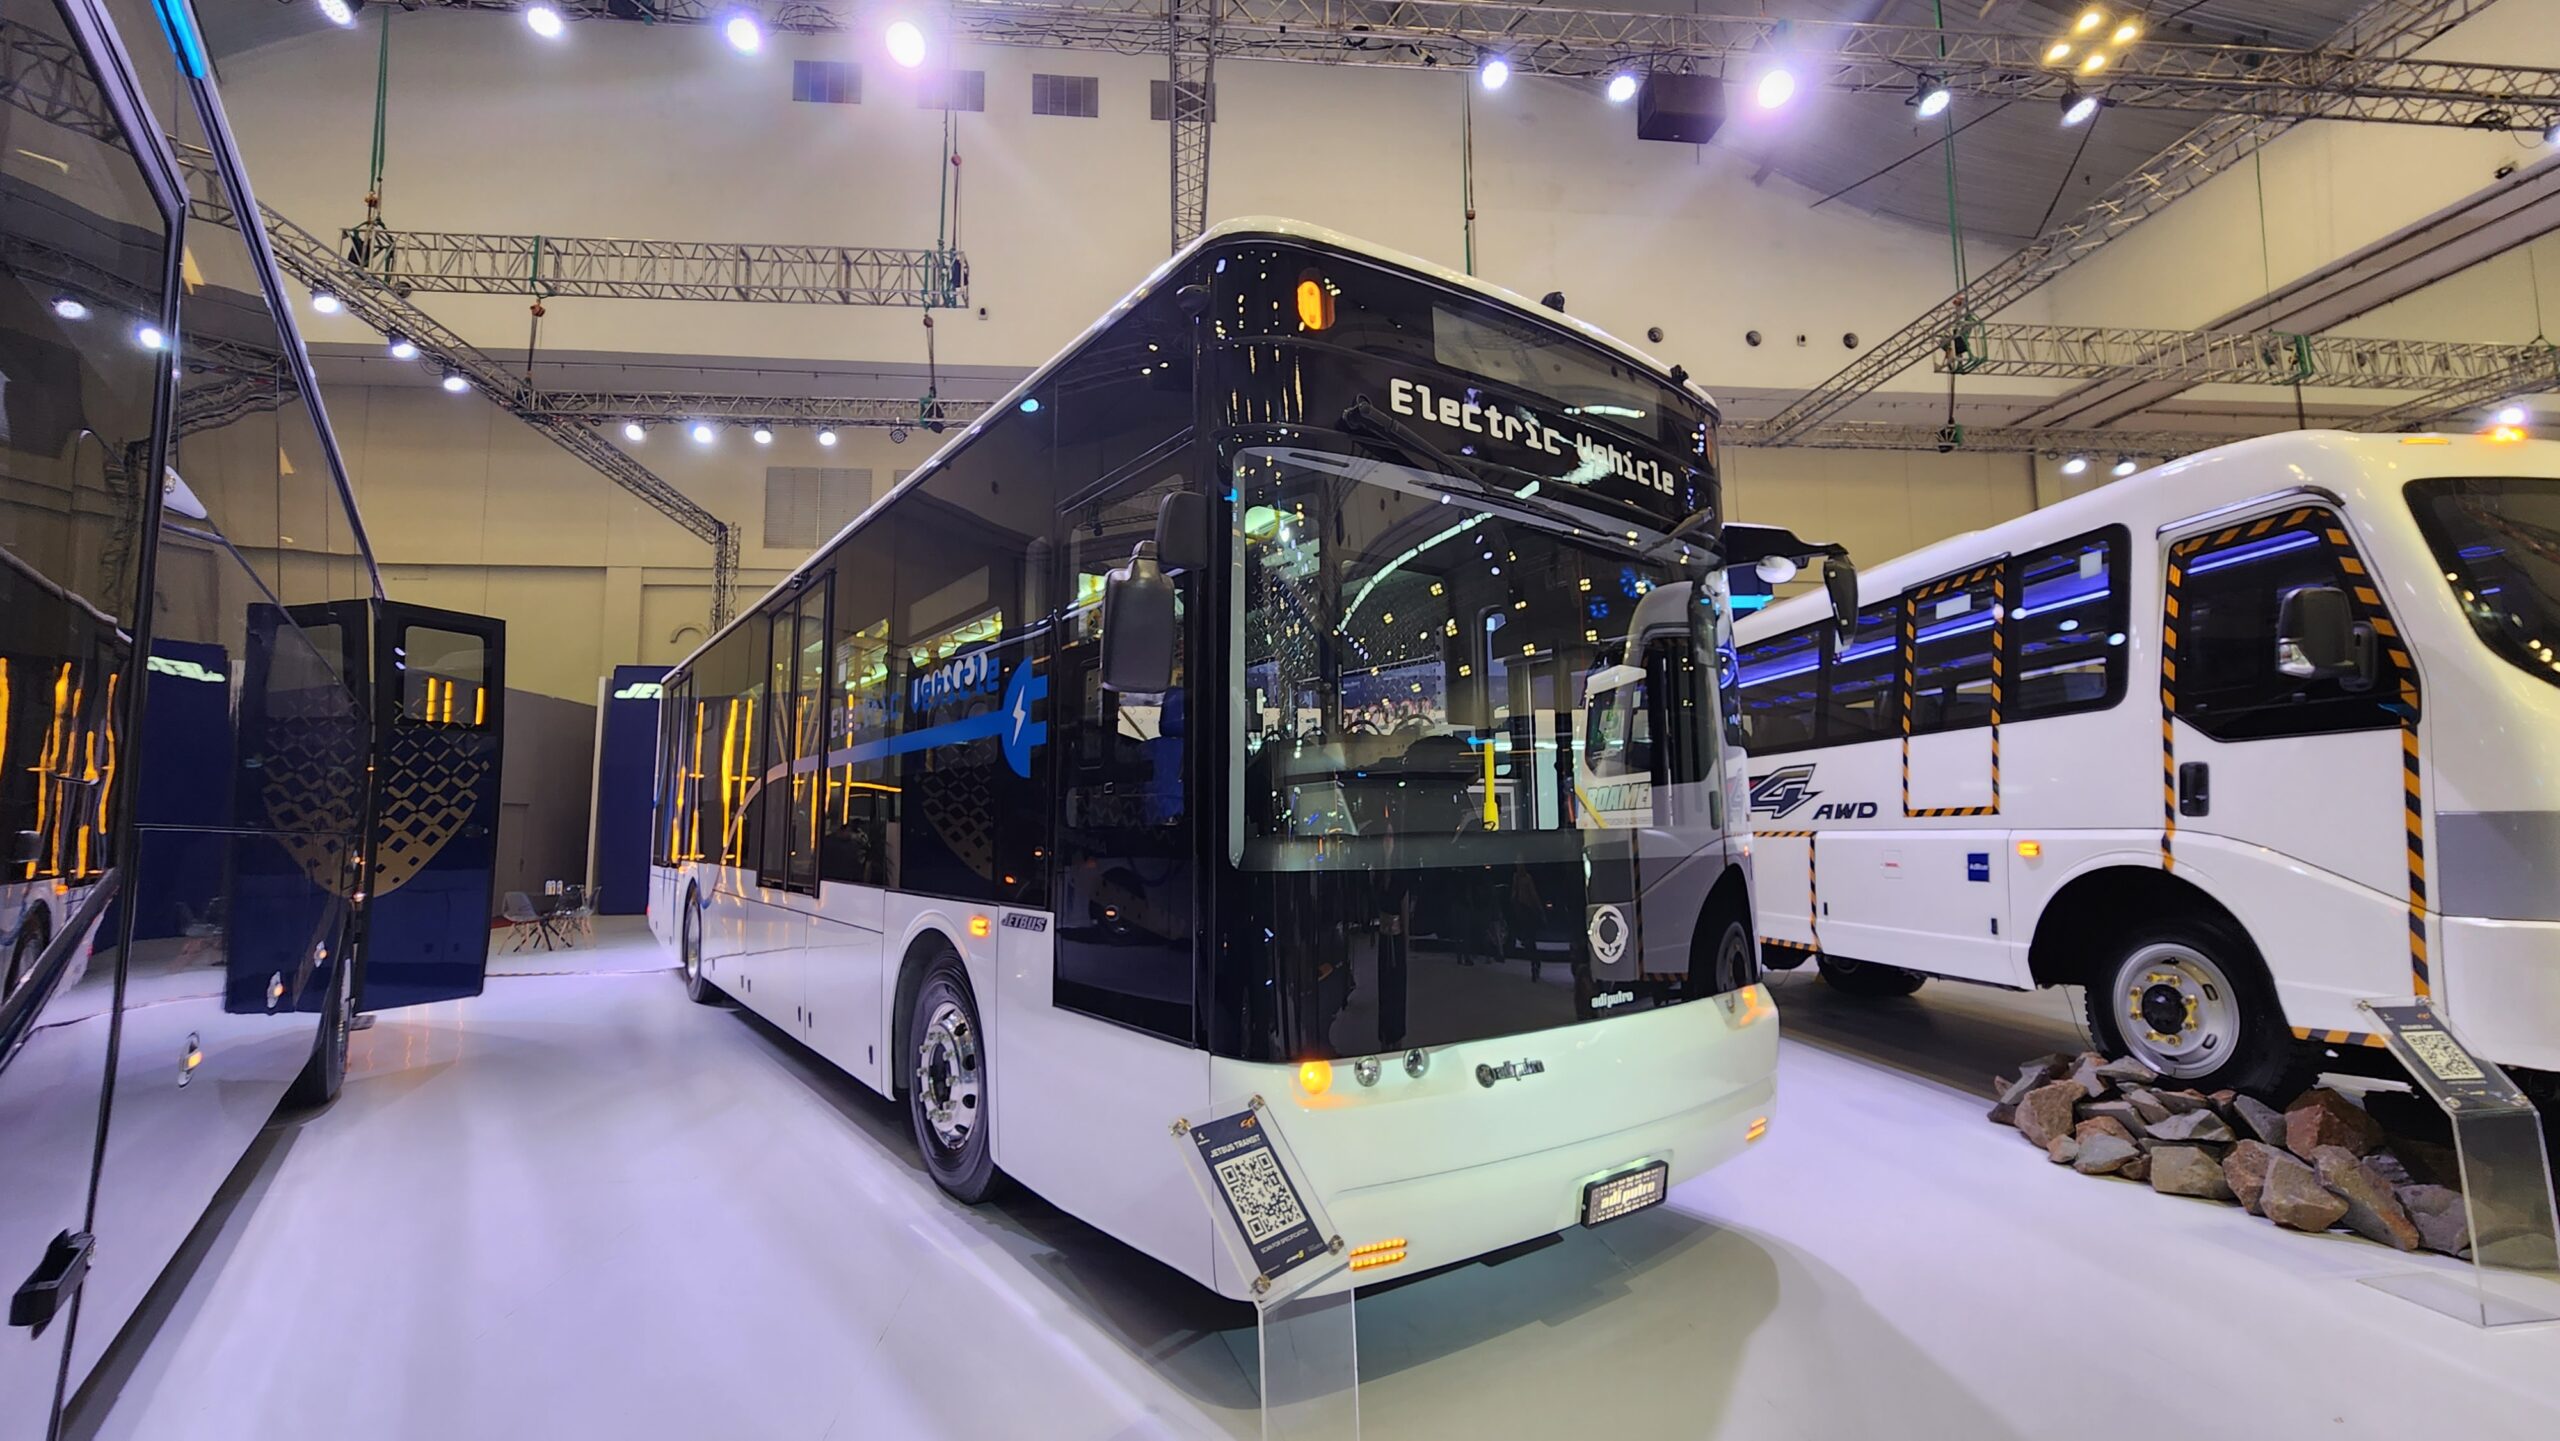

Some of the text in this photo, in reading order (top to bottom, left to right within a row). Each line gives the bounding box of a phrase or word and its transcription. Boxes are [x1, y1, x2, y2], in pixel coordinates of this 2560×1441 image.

[1389, 378, 1675, 496] Electric Vehicle
[1812, 802, 1878, 820] AWD
[1001, 912, 1048, 932] JETBUS
